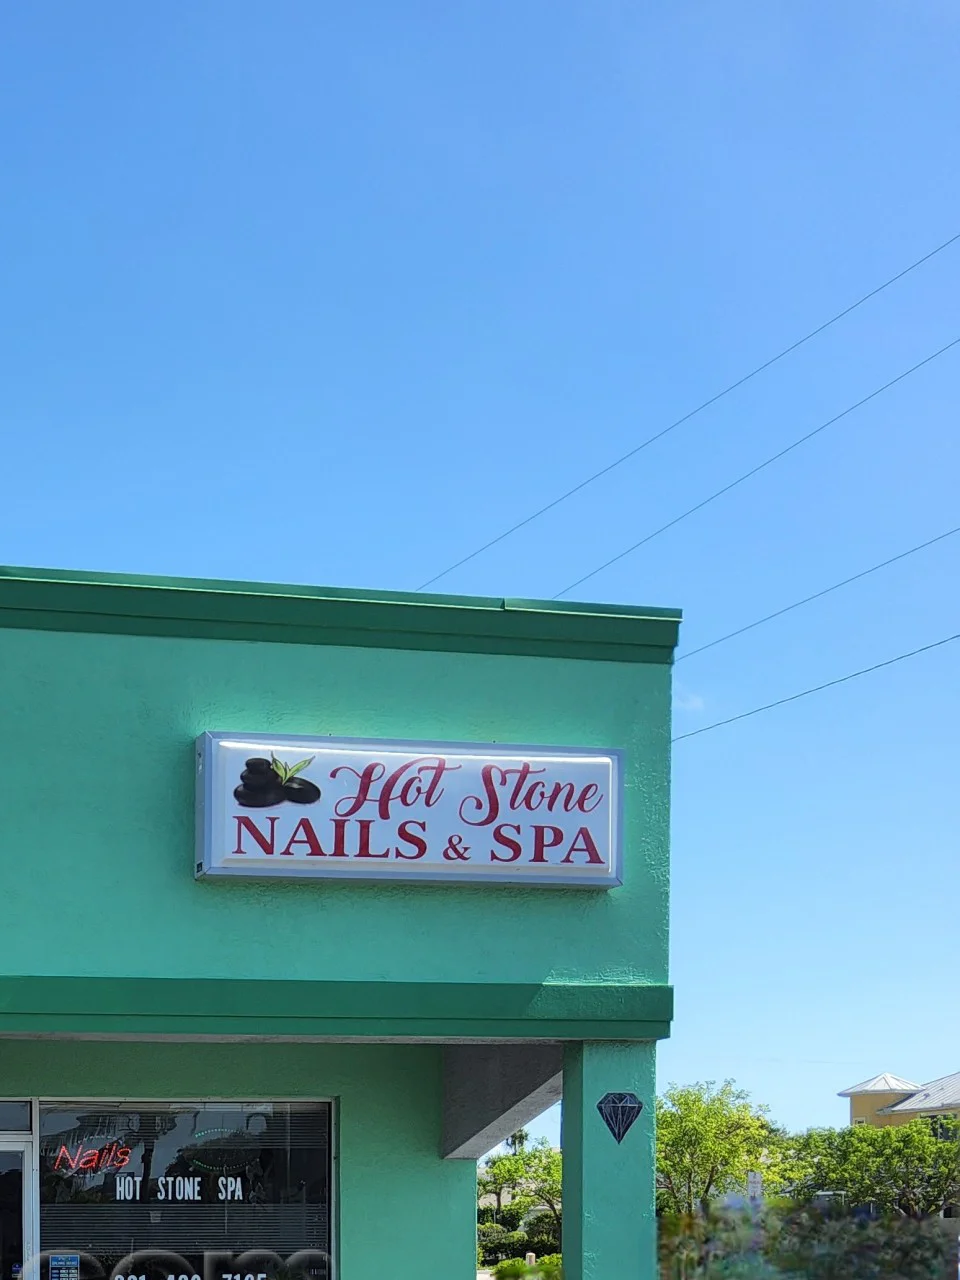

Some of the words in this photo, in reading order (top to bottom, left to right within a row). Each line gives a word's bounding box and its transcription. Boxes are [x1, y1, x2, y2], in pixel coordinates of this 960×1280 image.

[329, 756, 462, 821] Hot
[459, 760, 606, 827] Stone
[231, 815, 429, 860] NAILS
[442, 834, 472, 862] &
[489, 822, 606, 865] SPA
[53, 1142, 132, 1172] Nails
[116, 1176, 142, 1201] HOT
[157, 1176, 202, 1202] STONE
[218, 1176, 244, 1202] SPA
